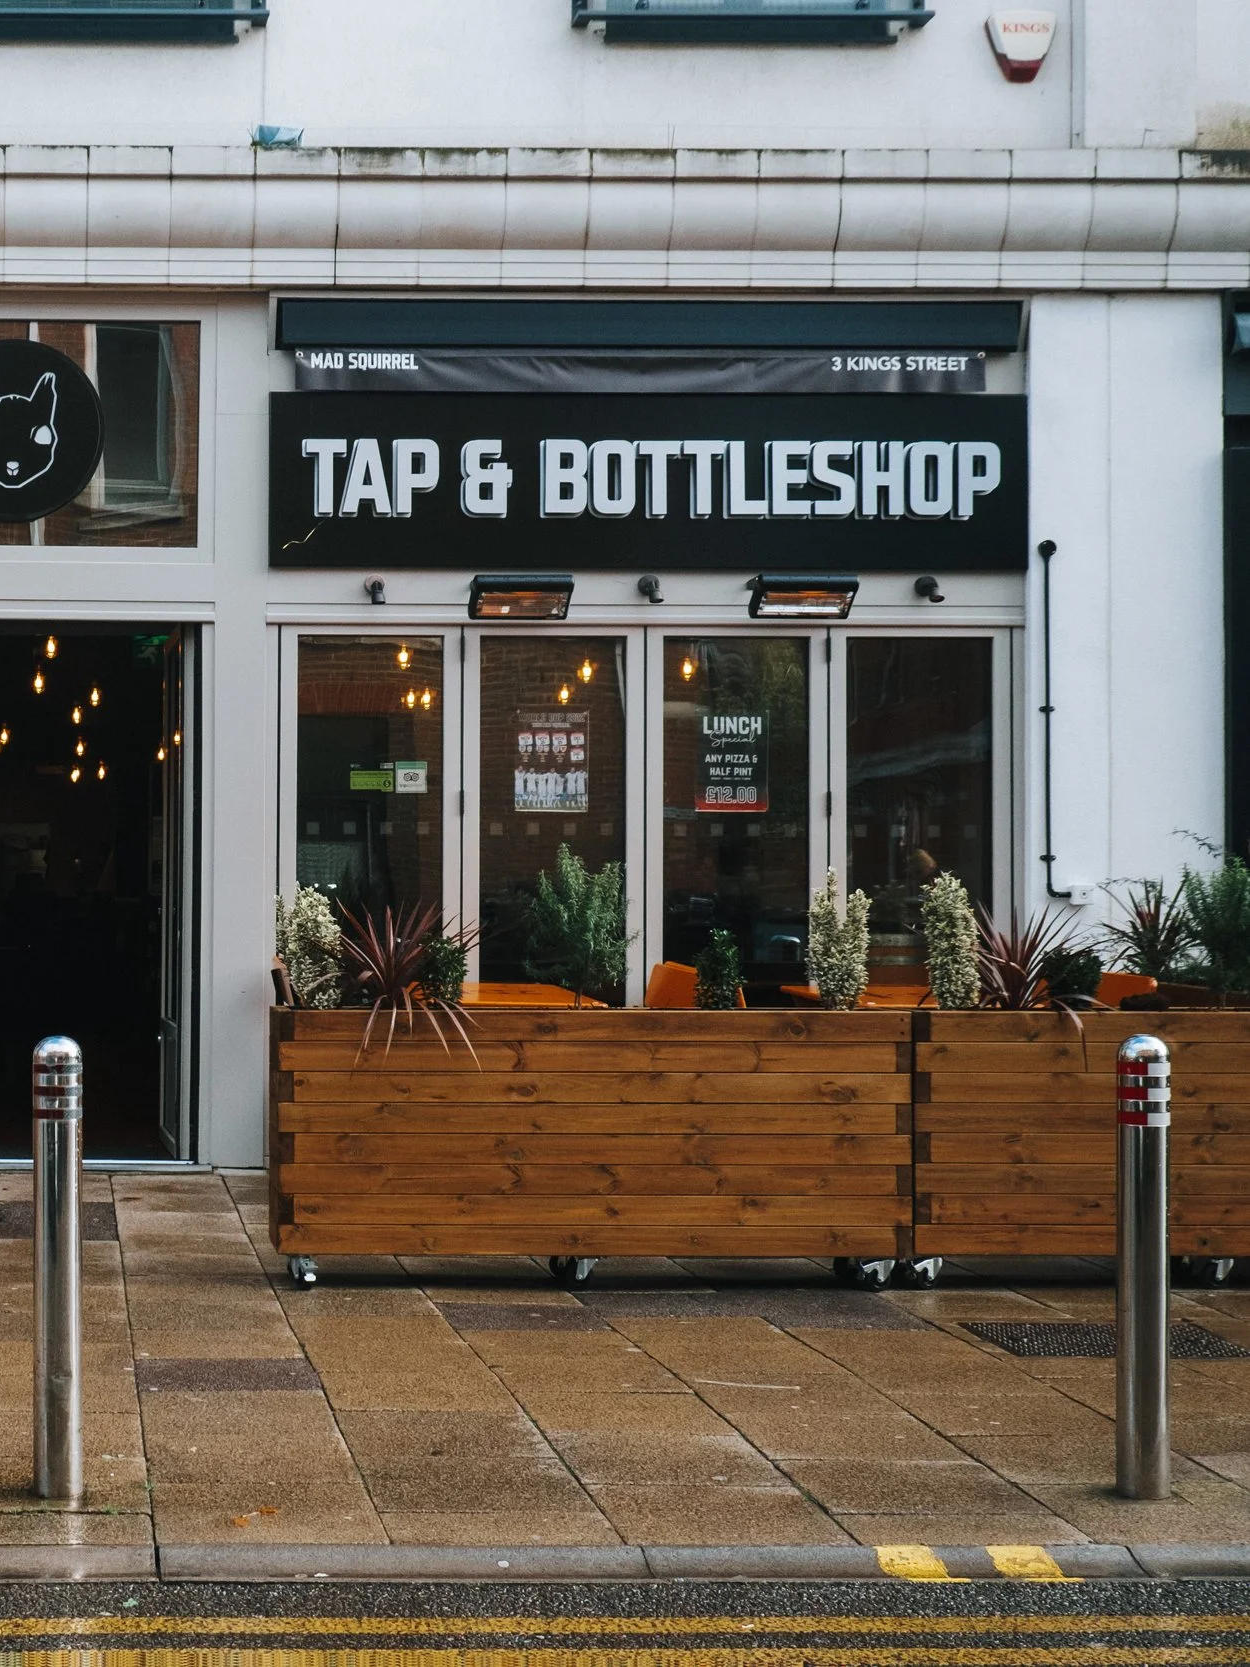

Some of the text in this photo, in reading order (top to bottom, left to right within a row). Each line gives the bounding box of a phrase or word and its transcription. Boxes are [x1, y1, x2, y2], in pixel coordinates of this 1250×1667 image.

[1002, 22, 1050, 33] KINGS
[310, 352, 419, 371] MAD SQUIRREL
[831, 356, 969, 373] 3 KINGS STREET
[302, 437, 1001, 521] TAP & BOTTLESHOP
[703, 716, 762, 735] LUNCH
[710, 729, 756, 748] Special
[705, 754, 758, 763] ANY PIZZA &
[710, 767, 753, 776] HALF PINT
[706, 786, 757, 804] £12.00
